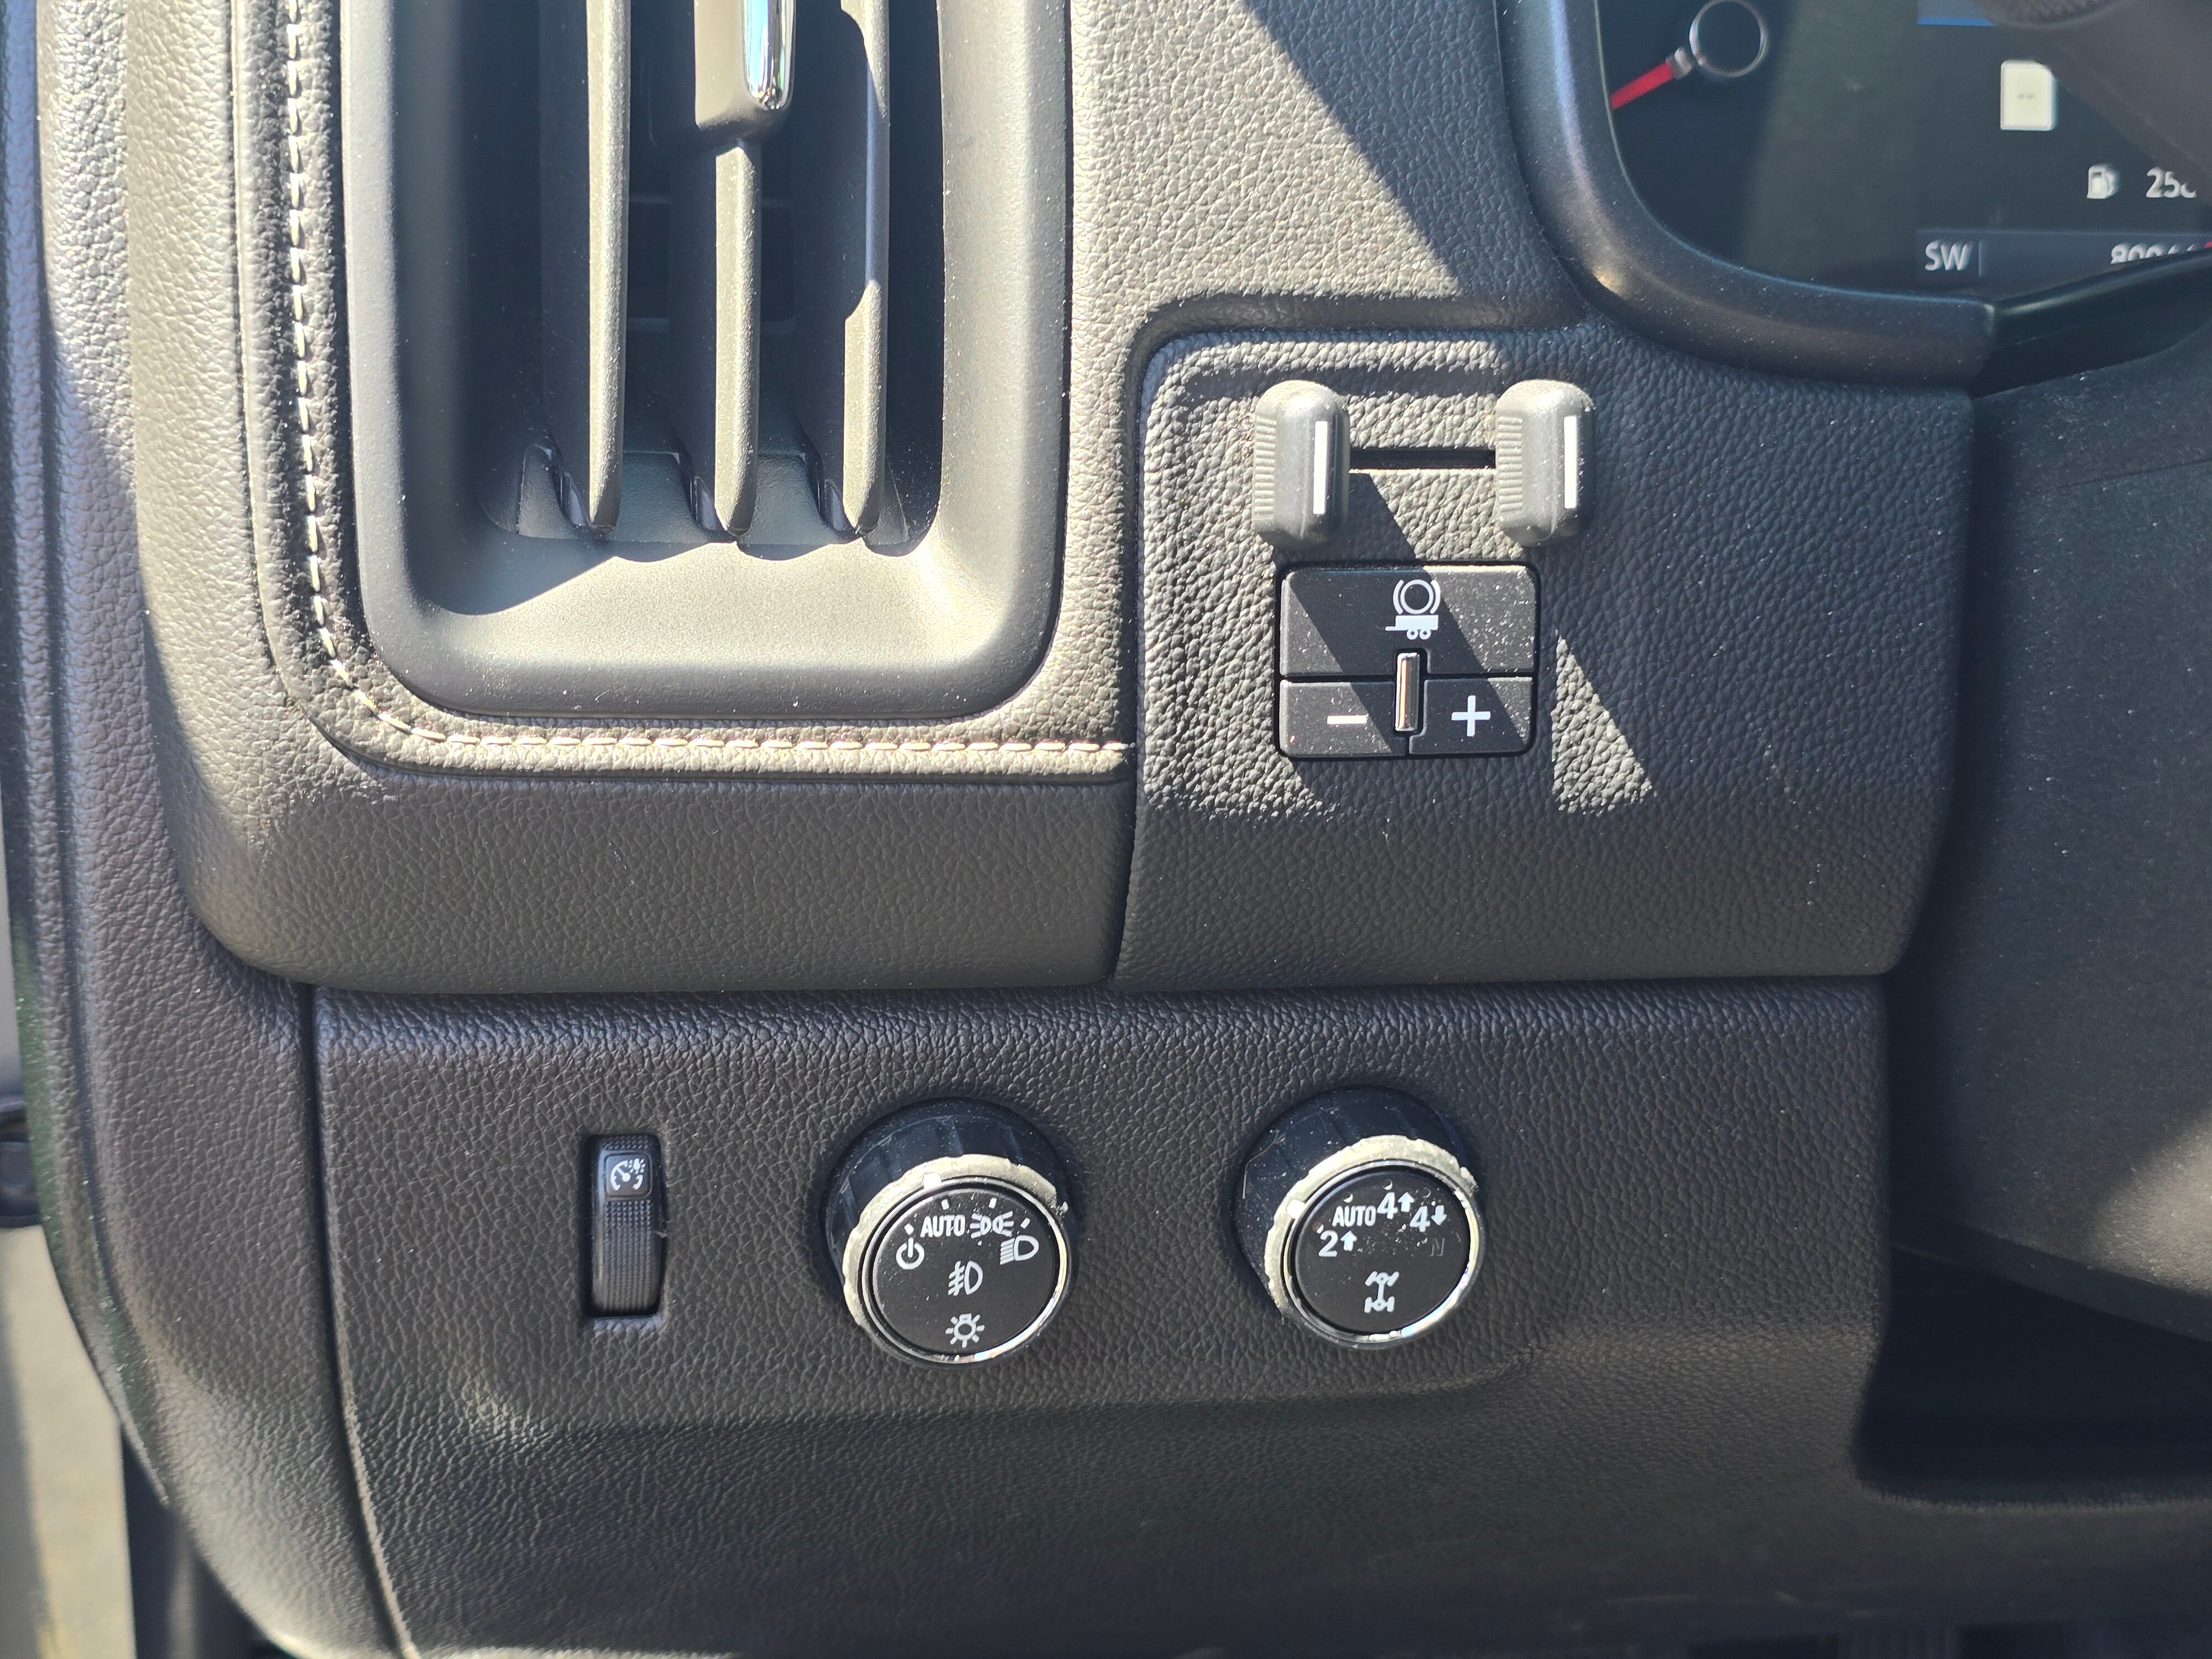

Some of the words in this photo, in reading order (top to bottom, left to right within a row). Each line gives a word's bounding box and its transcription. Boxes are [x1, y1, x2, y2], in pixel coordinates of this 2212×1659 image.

[1924, 240, 1973, 271] SW
[1332, 1205, 1377, 1227] AUTO
[1376, 1191, 1398, 1219] 4
[1409, 1205, 1431, 1233] 4
[920, 1214, 966, 1238] AUTO
[1318, 1229, 1338, 1258] 2
